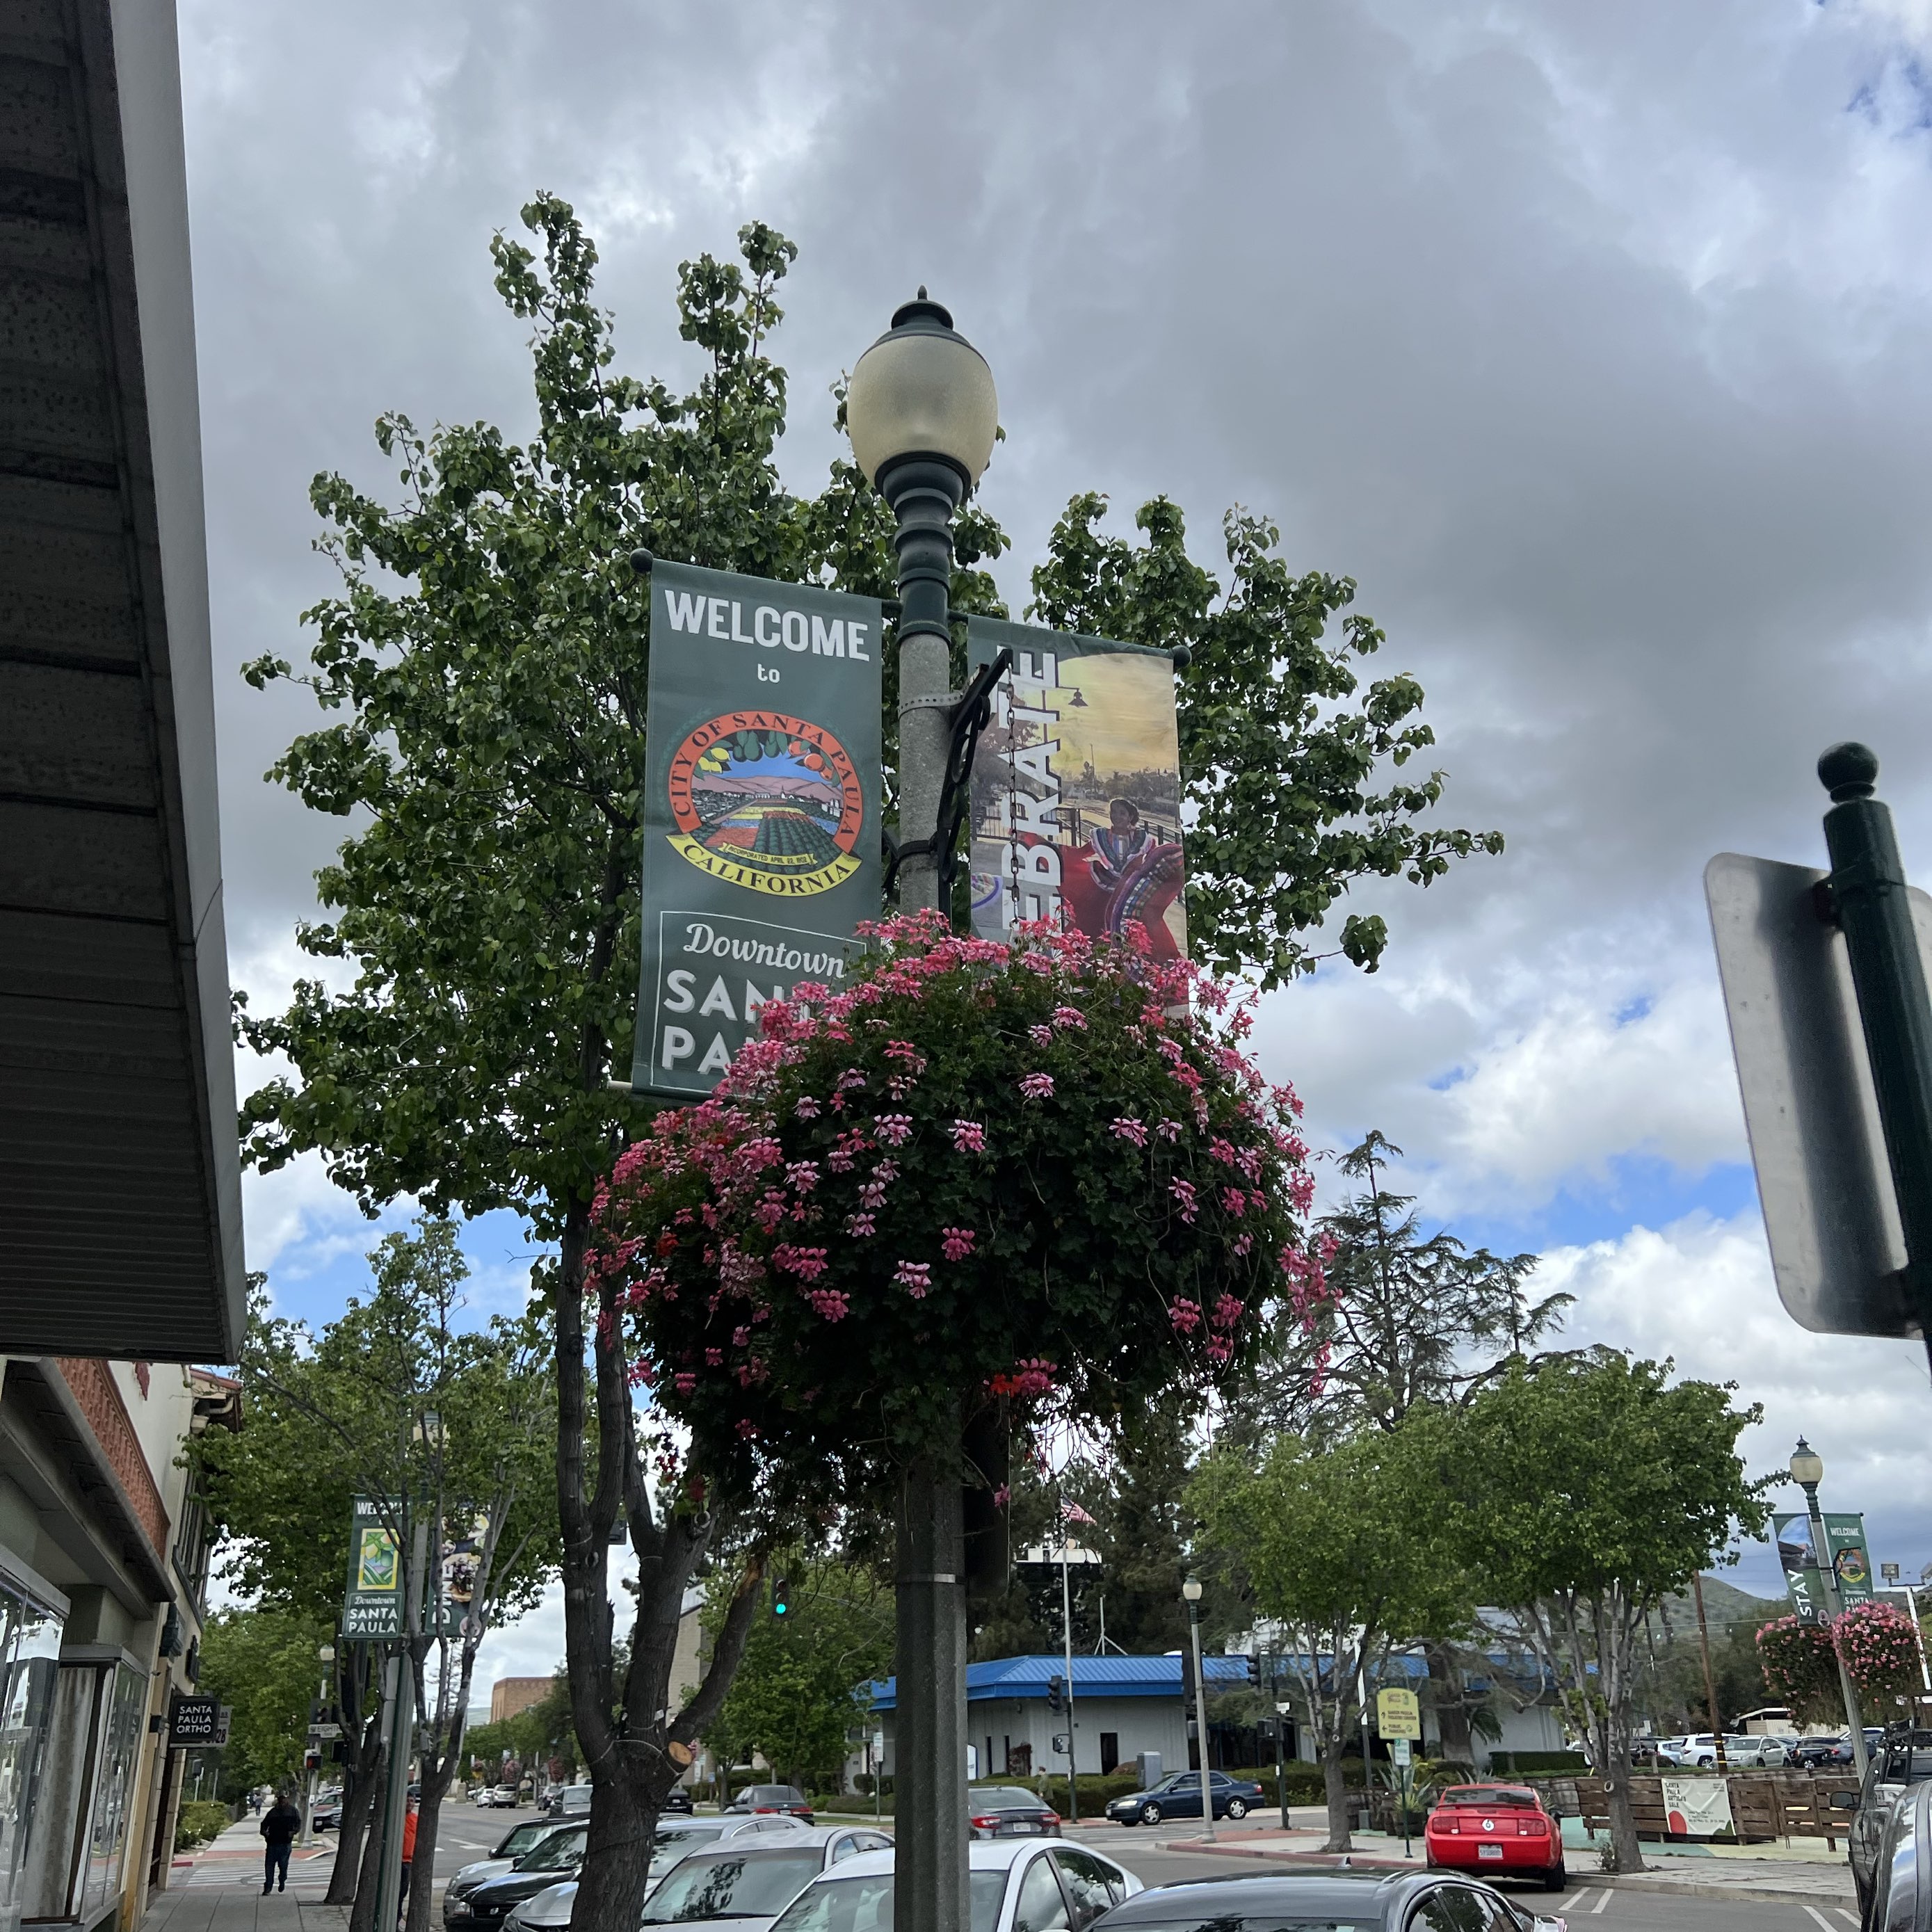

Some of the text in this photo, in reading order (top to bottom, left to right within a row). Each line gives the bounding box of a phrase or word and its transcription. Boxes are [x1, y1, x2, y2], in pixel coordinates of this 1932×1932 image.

[664, 590, 870, 661] WELCOME
[757, 663, 780, 684] to
[673, 714, 860, 837] CITY OF SANTA PAULA
[997, 645, 1063, 935] EBRATE
[727, 846, 768, 862] INCORPORATED
[683, 843, 851, 894] CALIFORNIA
[683, 923, 846, 979] Downtown
[663, 969, 811, 1024] SAN
[1830, 1527, 1860, 1536] WELCOME
[354, 1595, 396, 1605] Downtown
[1787, 1569, 1812, 1617] STAY
[349, 1607, 398, 1620] SANTA
[348, 1621, 396, 1633] PAULA
[179, 1705, 212, 1714] SANTA
[177, 1715, 211, 1724] PAULA
[176, 1725, 211, 1734] ORTHO
